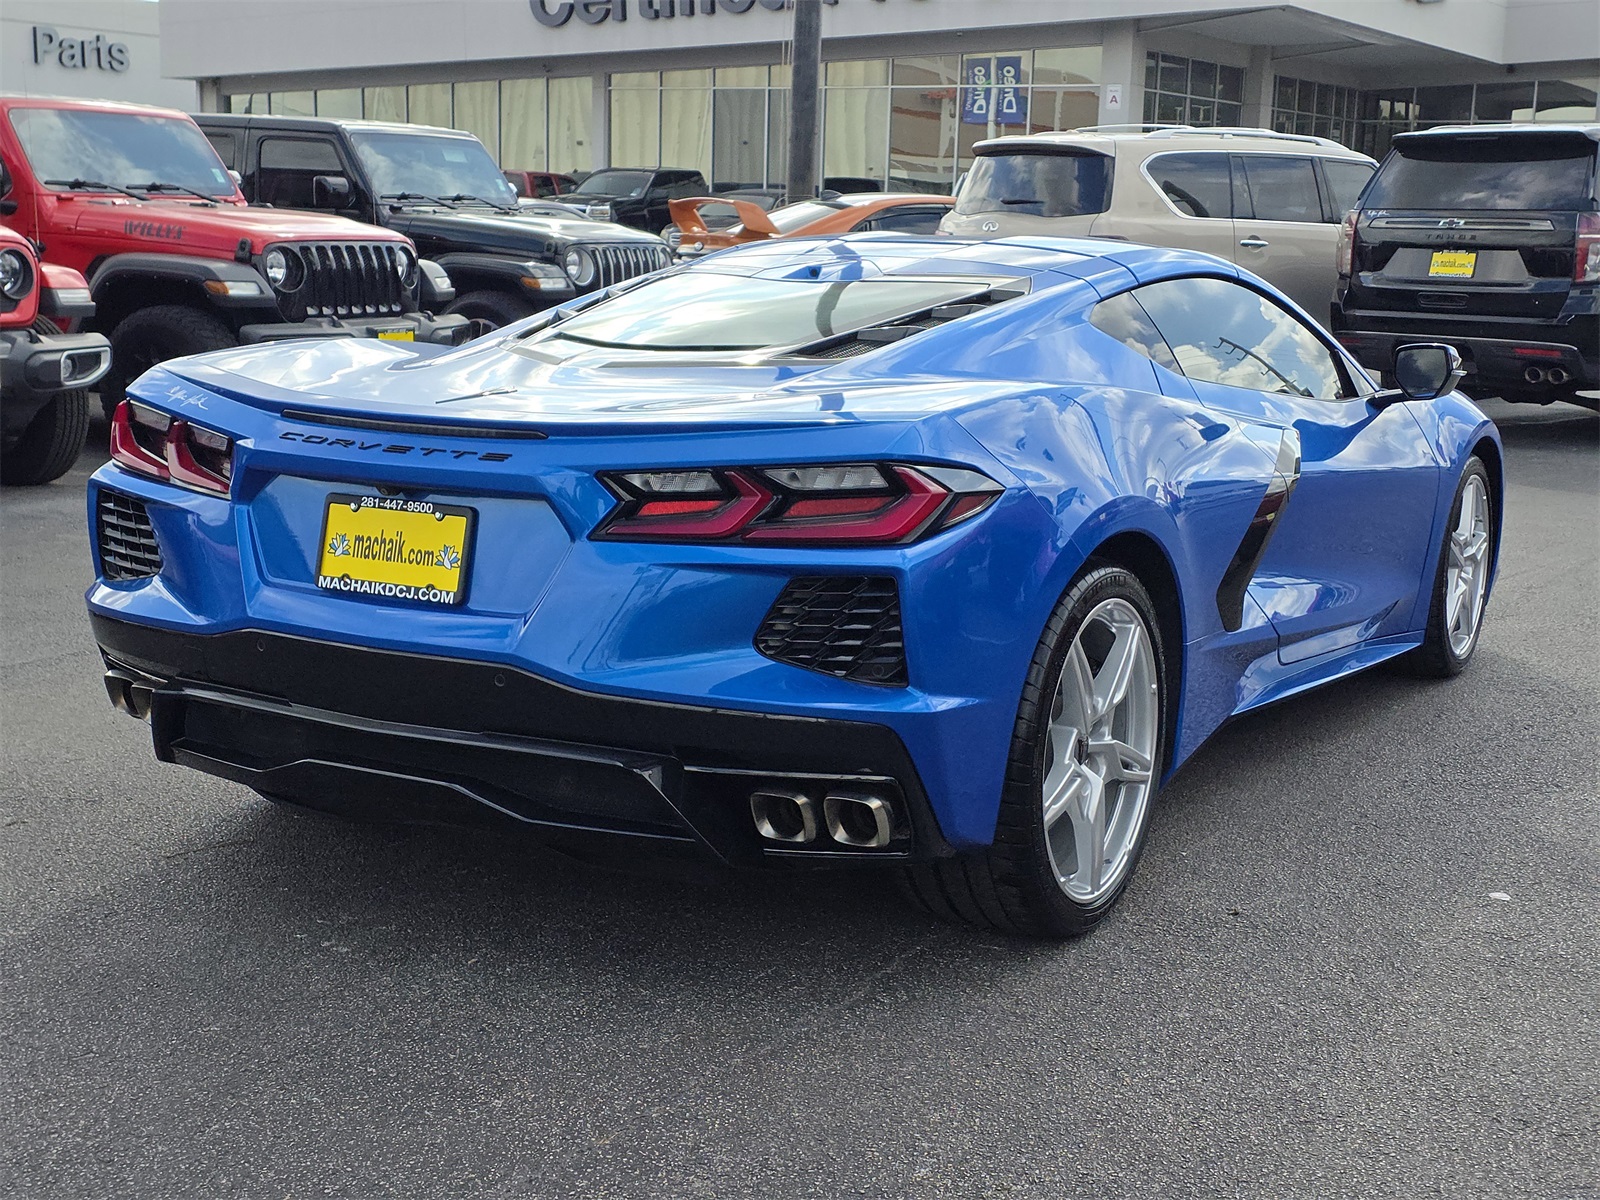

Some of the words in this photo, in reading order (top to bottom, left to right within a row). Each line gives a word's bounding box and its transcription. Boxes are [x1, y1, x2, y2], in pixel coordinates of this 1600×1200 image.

[32, 25, 130, 72] Parts
[279, 431, 513, 462] CORVETTE
[360, 496, 434, 514] 281-447-9500
[351, 529, 435, 567] machaik.com
[317, 575, 455, 605] MACHAIKDCJ.COM
